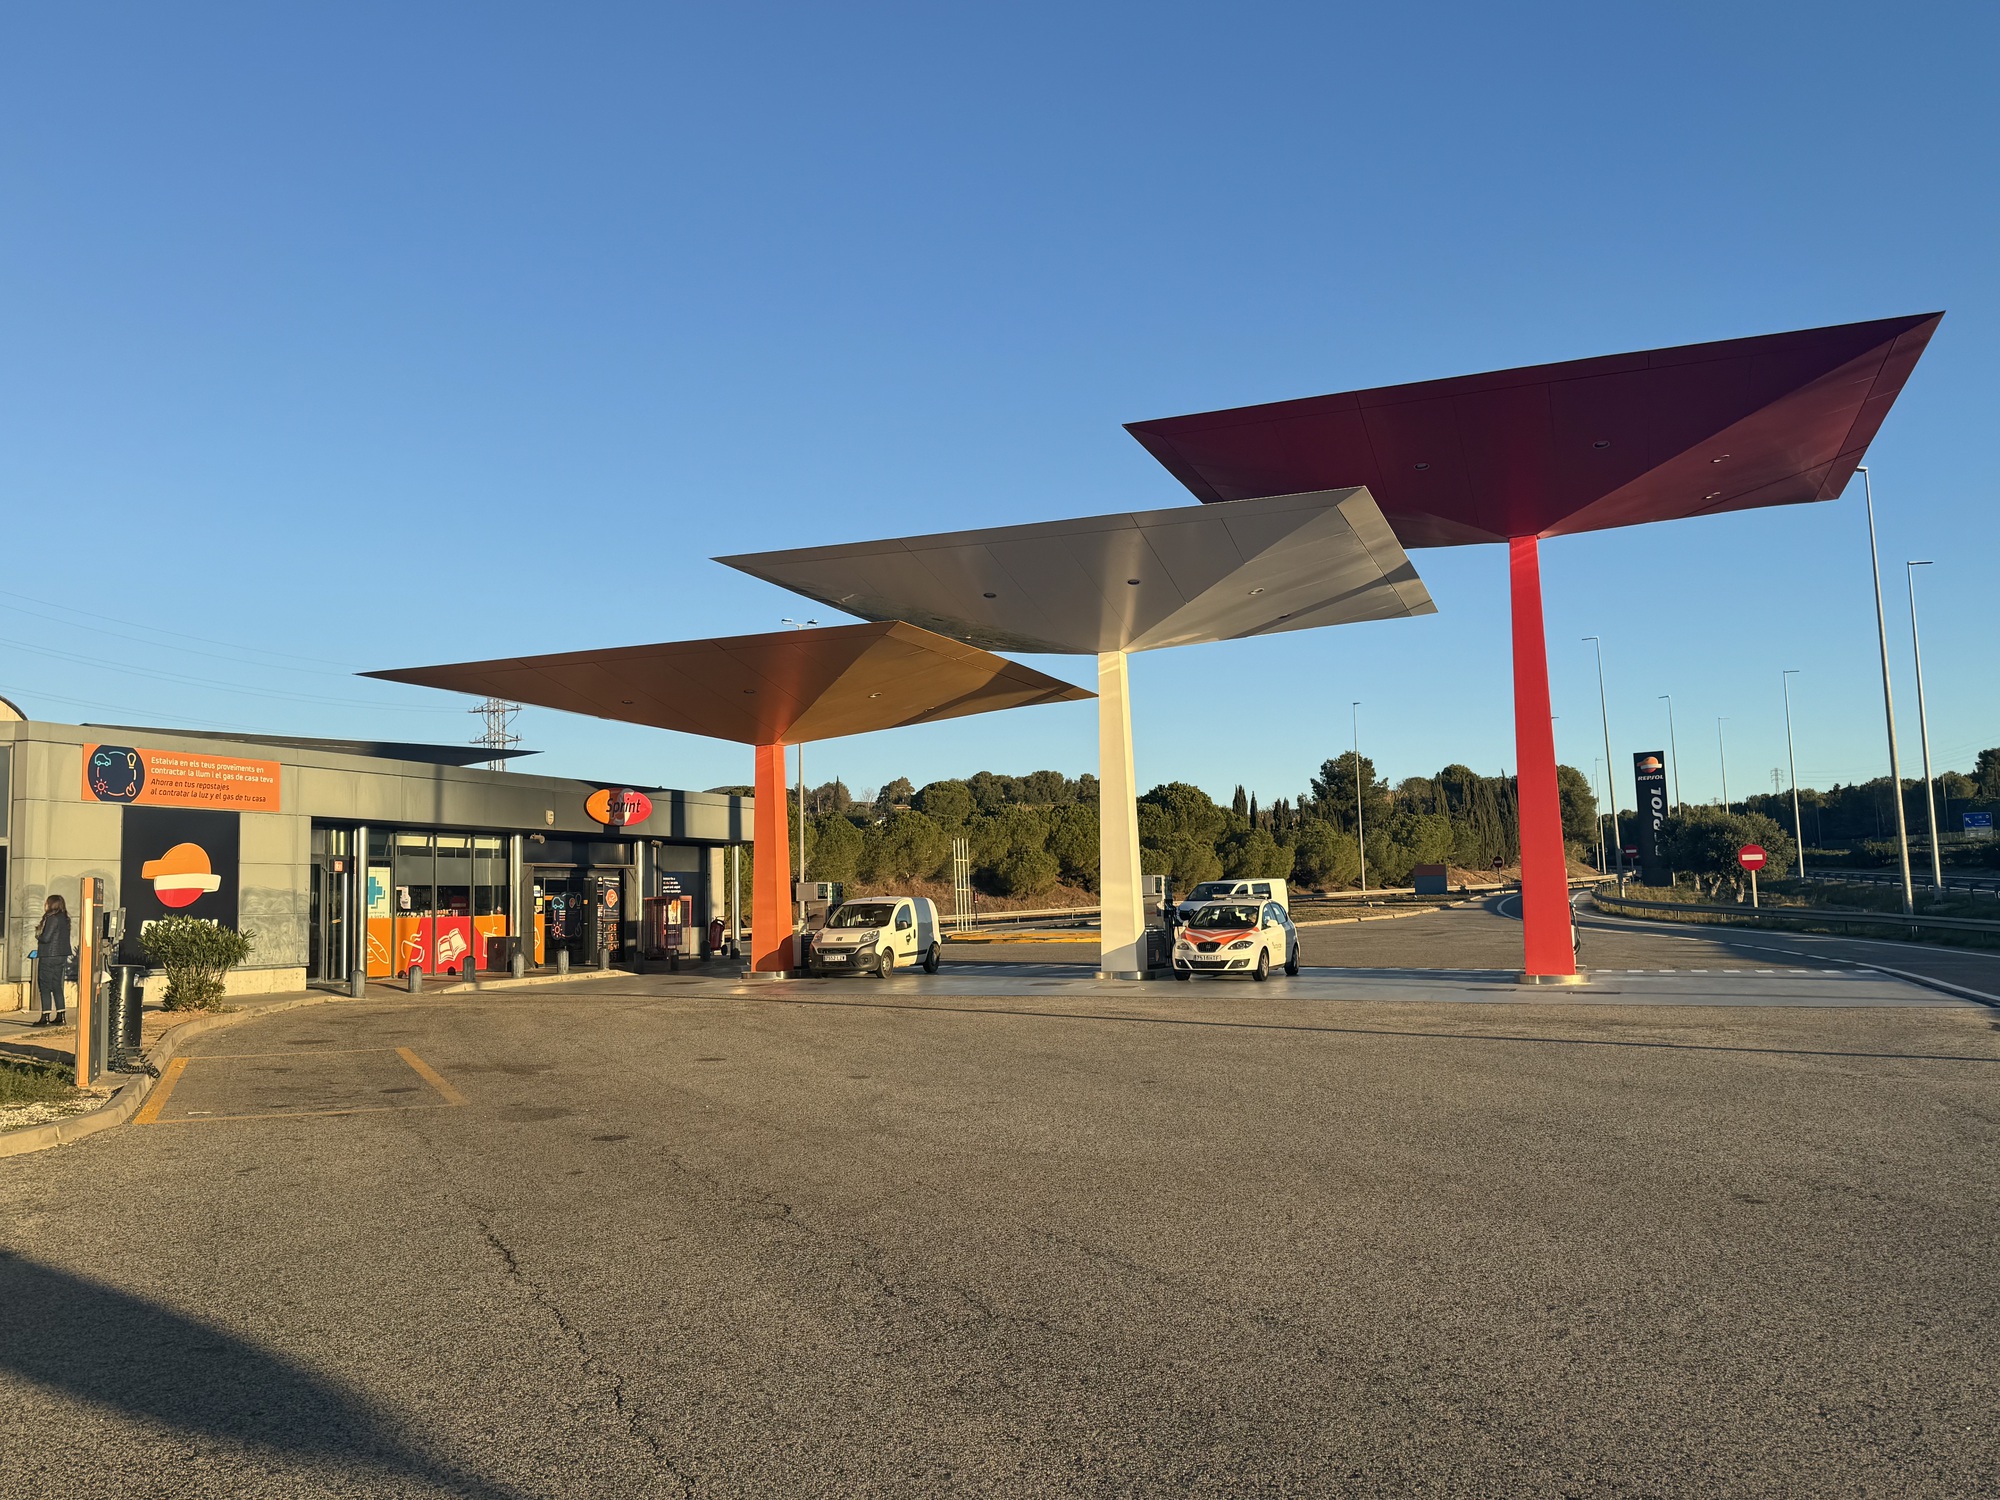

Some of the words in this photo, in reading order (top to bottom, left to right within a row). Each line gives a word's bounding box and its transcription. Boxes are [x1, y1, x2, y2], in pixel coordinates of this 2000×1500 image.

[151, 756, 179, 766] Estalvia
[189, 760, 200, 768] els
[201, 761, 215, 769] teus
[216, 764, 255, 773] proveïments
[151, 767, 187, 776] contractar
[187, 769, 195, 777] la
[196, 769, 211, 778] llum
[222, 773, 235, 781] gas
[235, 773, 244, 781] de
[260, 776, 274, 784] teva
[151, 778, 173, 787] Ahorra
[196, 782, 230, 792] repostajes
[158, 789, 190, 798] contratar
[199, 791, 209, 799] luz
[209, 793, 215, 801] y
[215, 792, 222, 800] el
[222, 794, 234, 802] gas
[606, 797, 641, 818] Sprint
